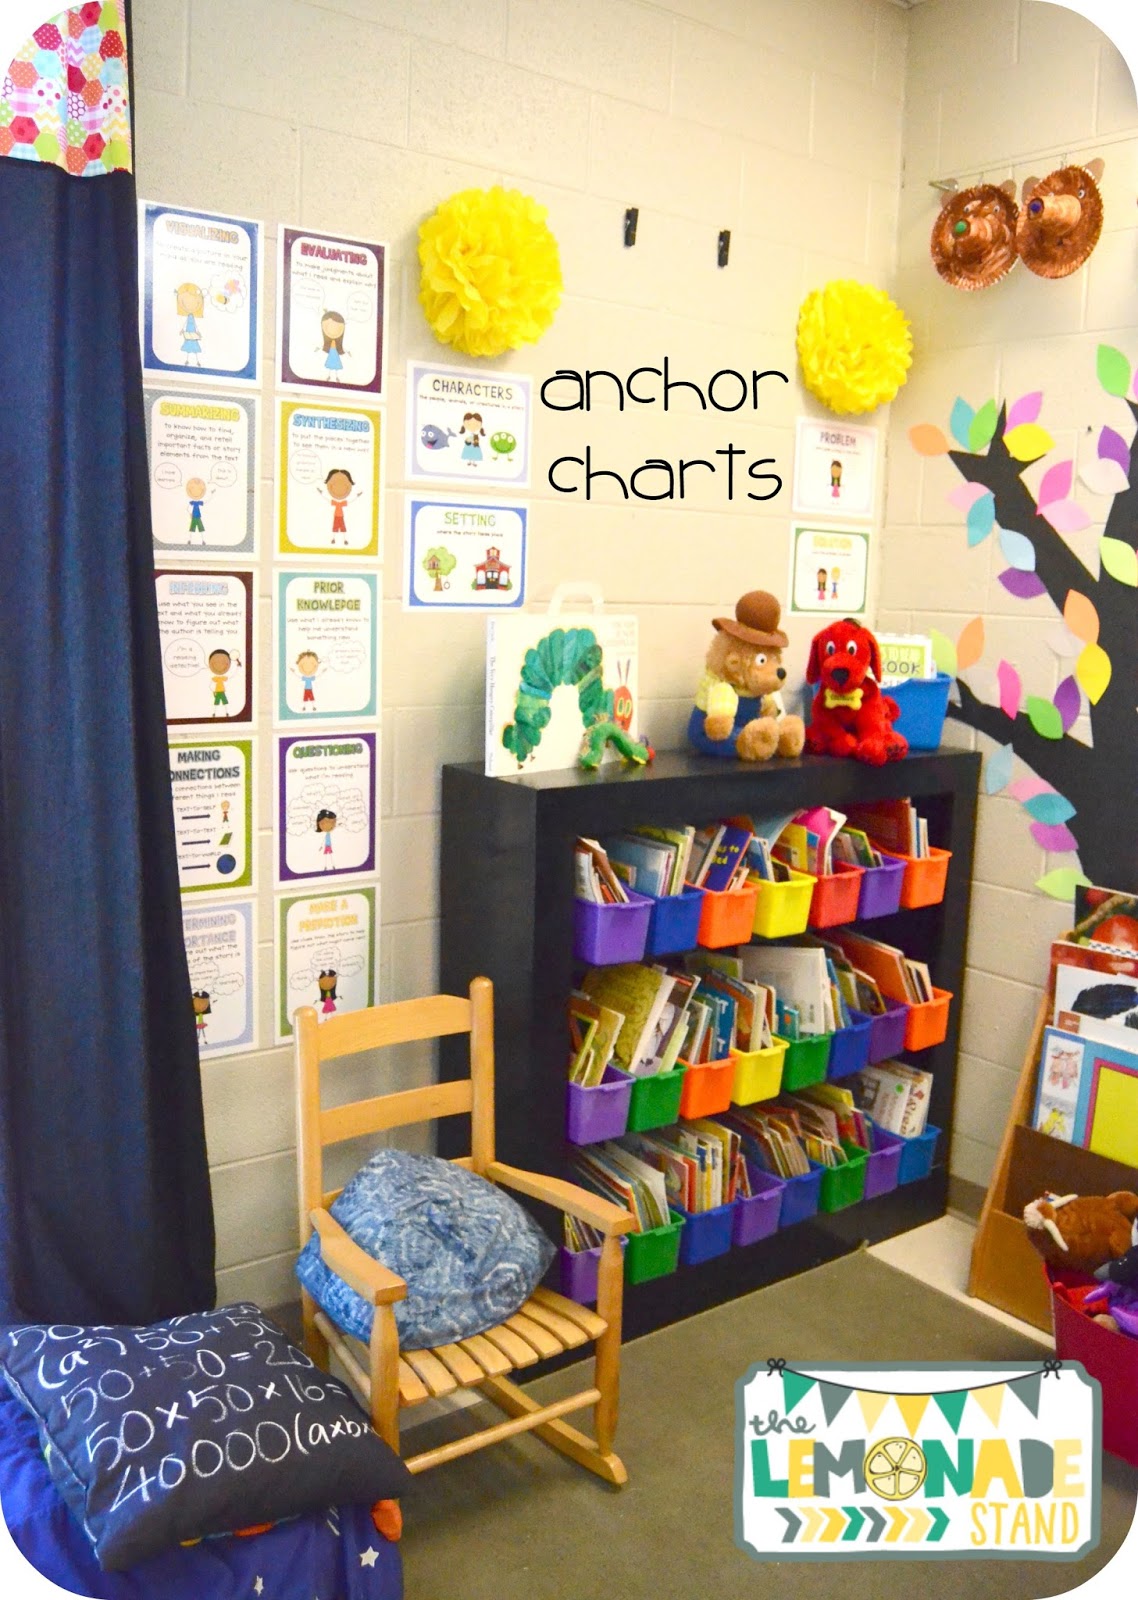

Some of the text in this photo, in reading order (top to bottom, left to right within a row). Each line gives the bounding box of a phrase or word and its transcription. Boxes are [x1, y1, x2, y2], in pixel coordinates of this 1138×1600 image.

[165, 220, 239, 244] VISUALIZING
[300, 242, 368, 266] EVALUATING
[432, 379, 513, 400] CHARACTERS
[160, 401, 241, 422] SUMMARIZING
[292, 413, 370, 433] SYNTHESIZING
[166, 433, 197, 442] organize,
[820, 431, 856, 446] PROBLEM
[157, 441, 191, 449] important
[193, 443, 211, 451] facts
[223, 446, 241, 454] story
[444, 511, 496, 527] SETTING
[313, 581, 345, 594] PRIOR
[296, 598, 361, 612] KNOWLEDGE
[186, 619, 207, 627] figure
[882, 660, 921, 674] OOK
[177, 749, 221, 764] MAKING
[292, 743, 364, 759] QUESTIONING
[170, 766, 240, 782] ONNECTIONS
[195, 793, 215, 801] things
[185, 913, 237, 931] ERMINING
[185, 930, 237, 948] ORTANCE
[208, 944, 225, 952] what
